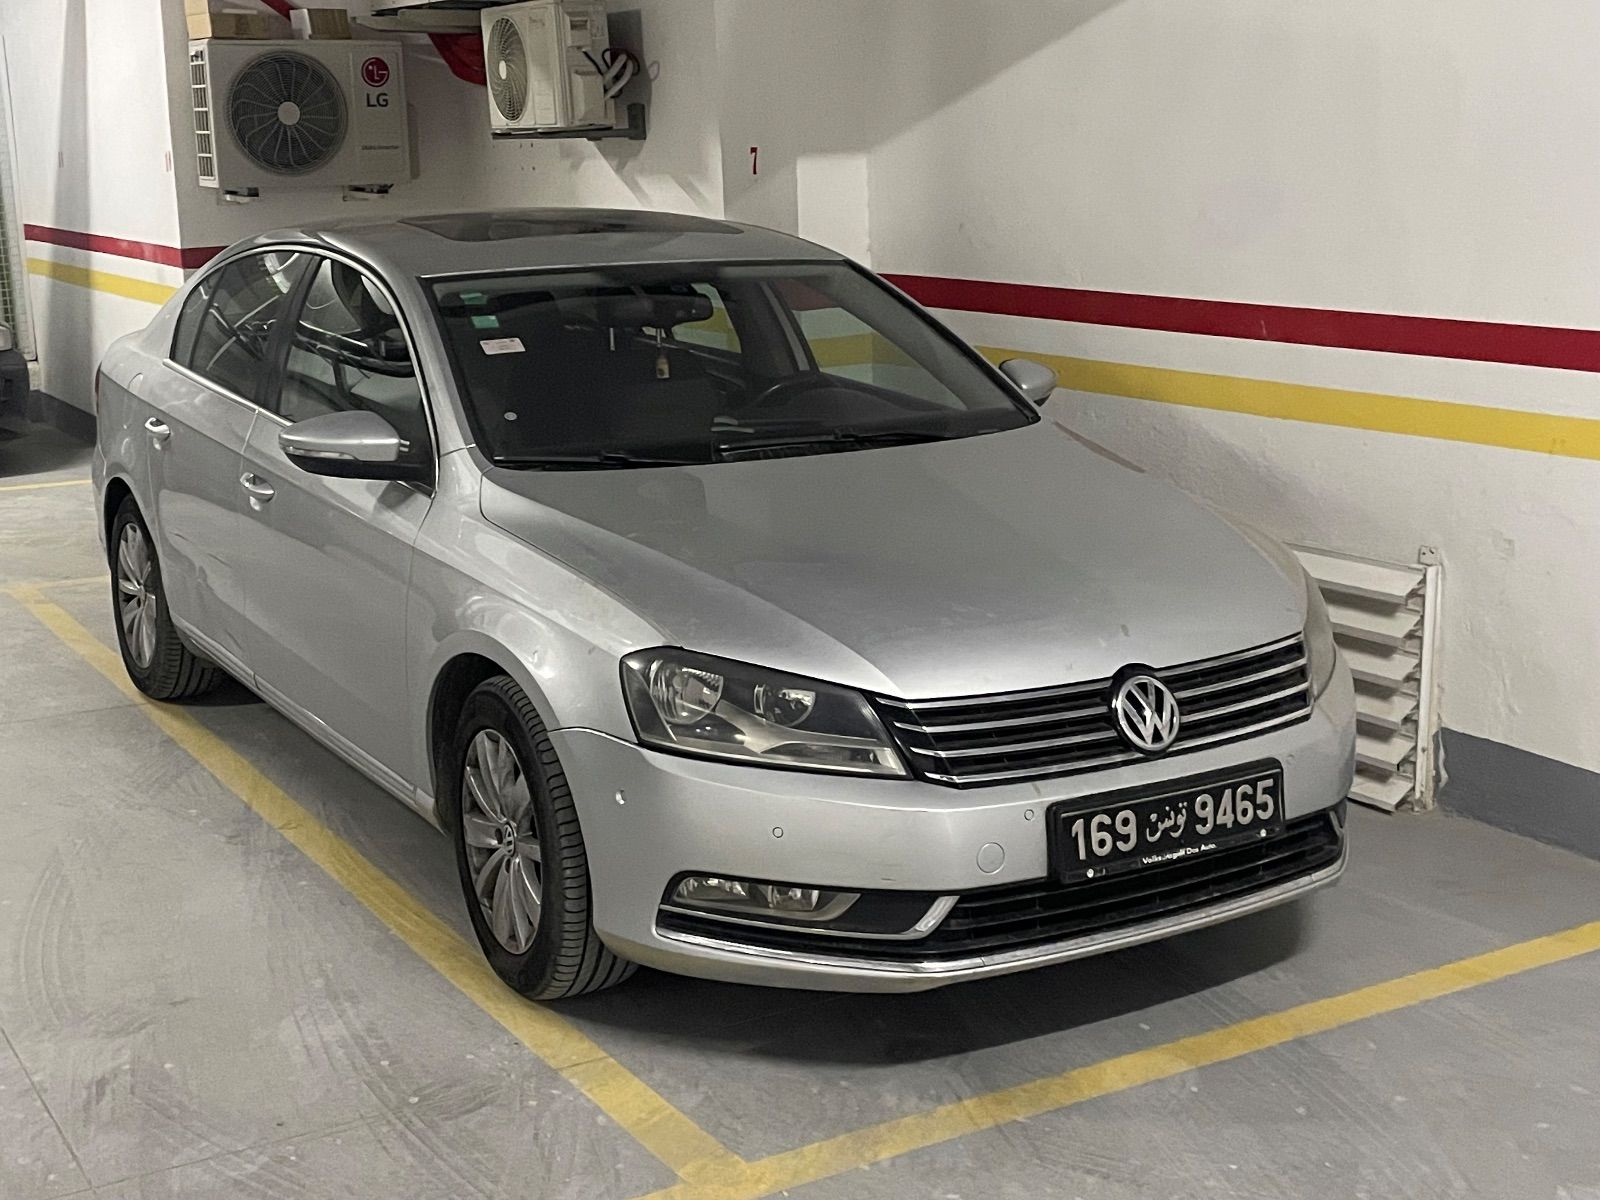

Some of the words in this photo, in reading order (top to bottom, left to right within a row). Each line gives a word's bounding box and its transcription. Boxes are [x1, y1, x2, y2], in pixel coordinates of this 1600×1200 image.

[366, 93, 389, 107] LG
[750, 146, 758, 175] 7
[1116, 675, 1180, 751] VW
[1071, 809, 1138, 861] 169
[1146, 801, 1188, 843] تونس
[1194, 778, 1275, 835] 9465
